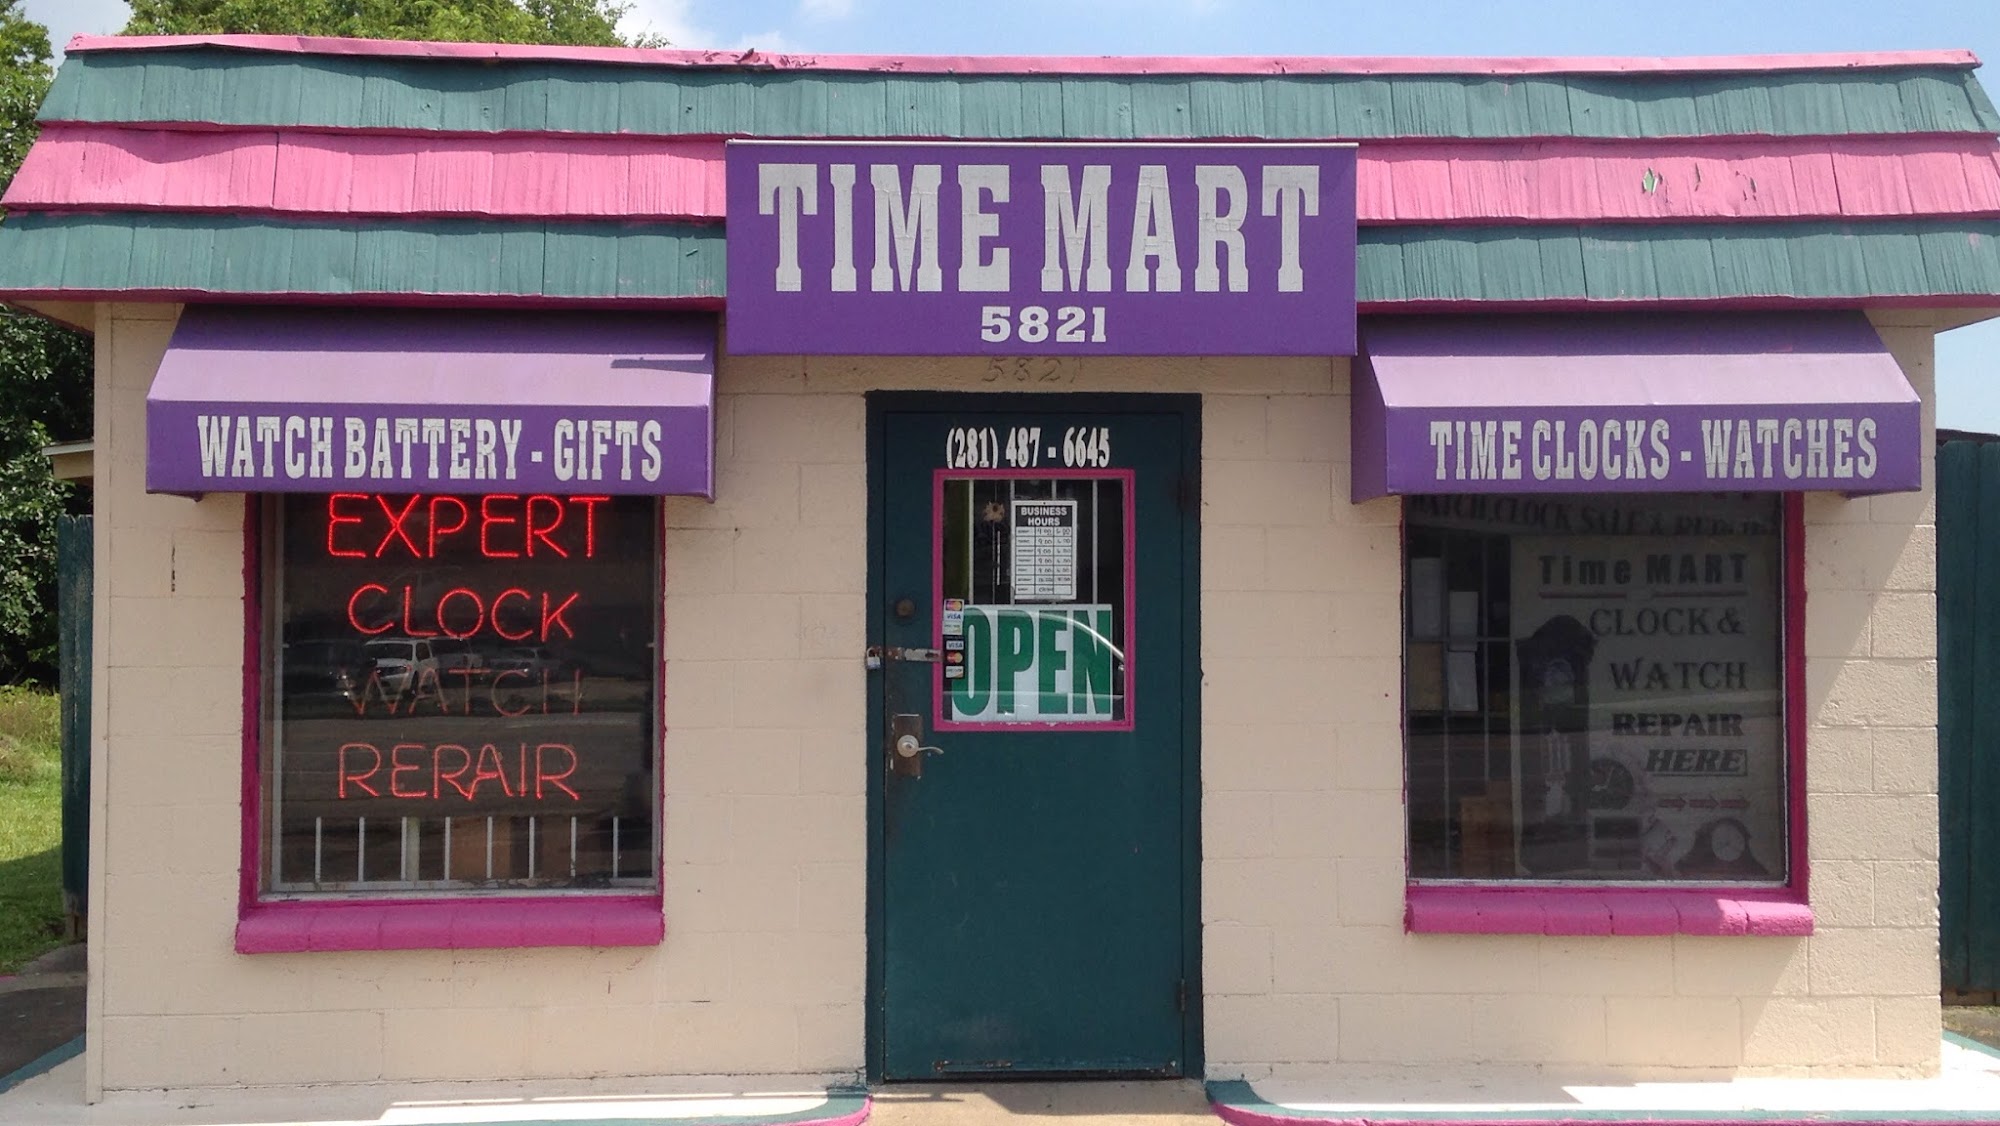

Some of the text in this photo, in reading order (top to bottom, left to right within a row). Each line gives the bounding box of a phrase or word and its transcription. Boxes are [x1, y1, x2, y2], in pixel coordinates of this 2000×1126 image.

[759, 163, 1320, 293] TIME MART
[981, 305, 1107, 343] 5821
[197, 415, 334, 479] WATCH
[344, 417, 522, 480] BATTERY
[553, 418, 663, 482] GIFTS
[947, 427, 998, 469] (281)
[1005, 427, 1041, 468] 487
[1063, 427, 1111, 468] 6645
[1430, 420, 1522, 480] TIME
[1531, 418, 1670, 481] CLOCKS
[1701, 417, 1877, 479] WATCHES
[327, 494, 610, 559] EXPERT
[1020, 506, 1067, 516] BUSINESS
[1027, 517, 1060, 526] HOURS
[1538, 553, 1748, 585] Time MART
[346, 583, 580, 642] CLOCK
[1589, 606, 1745, 637] CLOCK &
[953, 608, 1111, 717] OPEN
[1609, 656, 1748, 691] WATCH
[341, 665, 580, 717] WATCH
[1612, 712, 1744, 738] REPAIR
[1645, 748, 1742, 774] HERE
